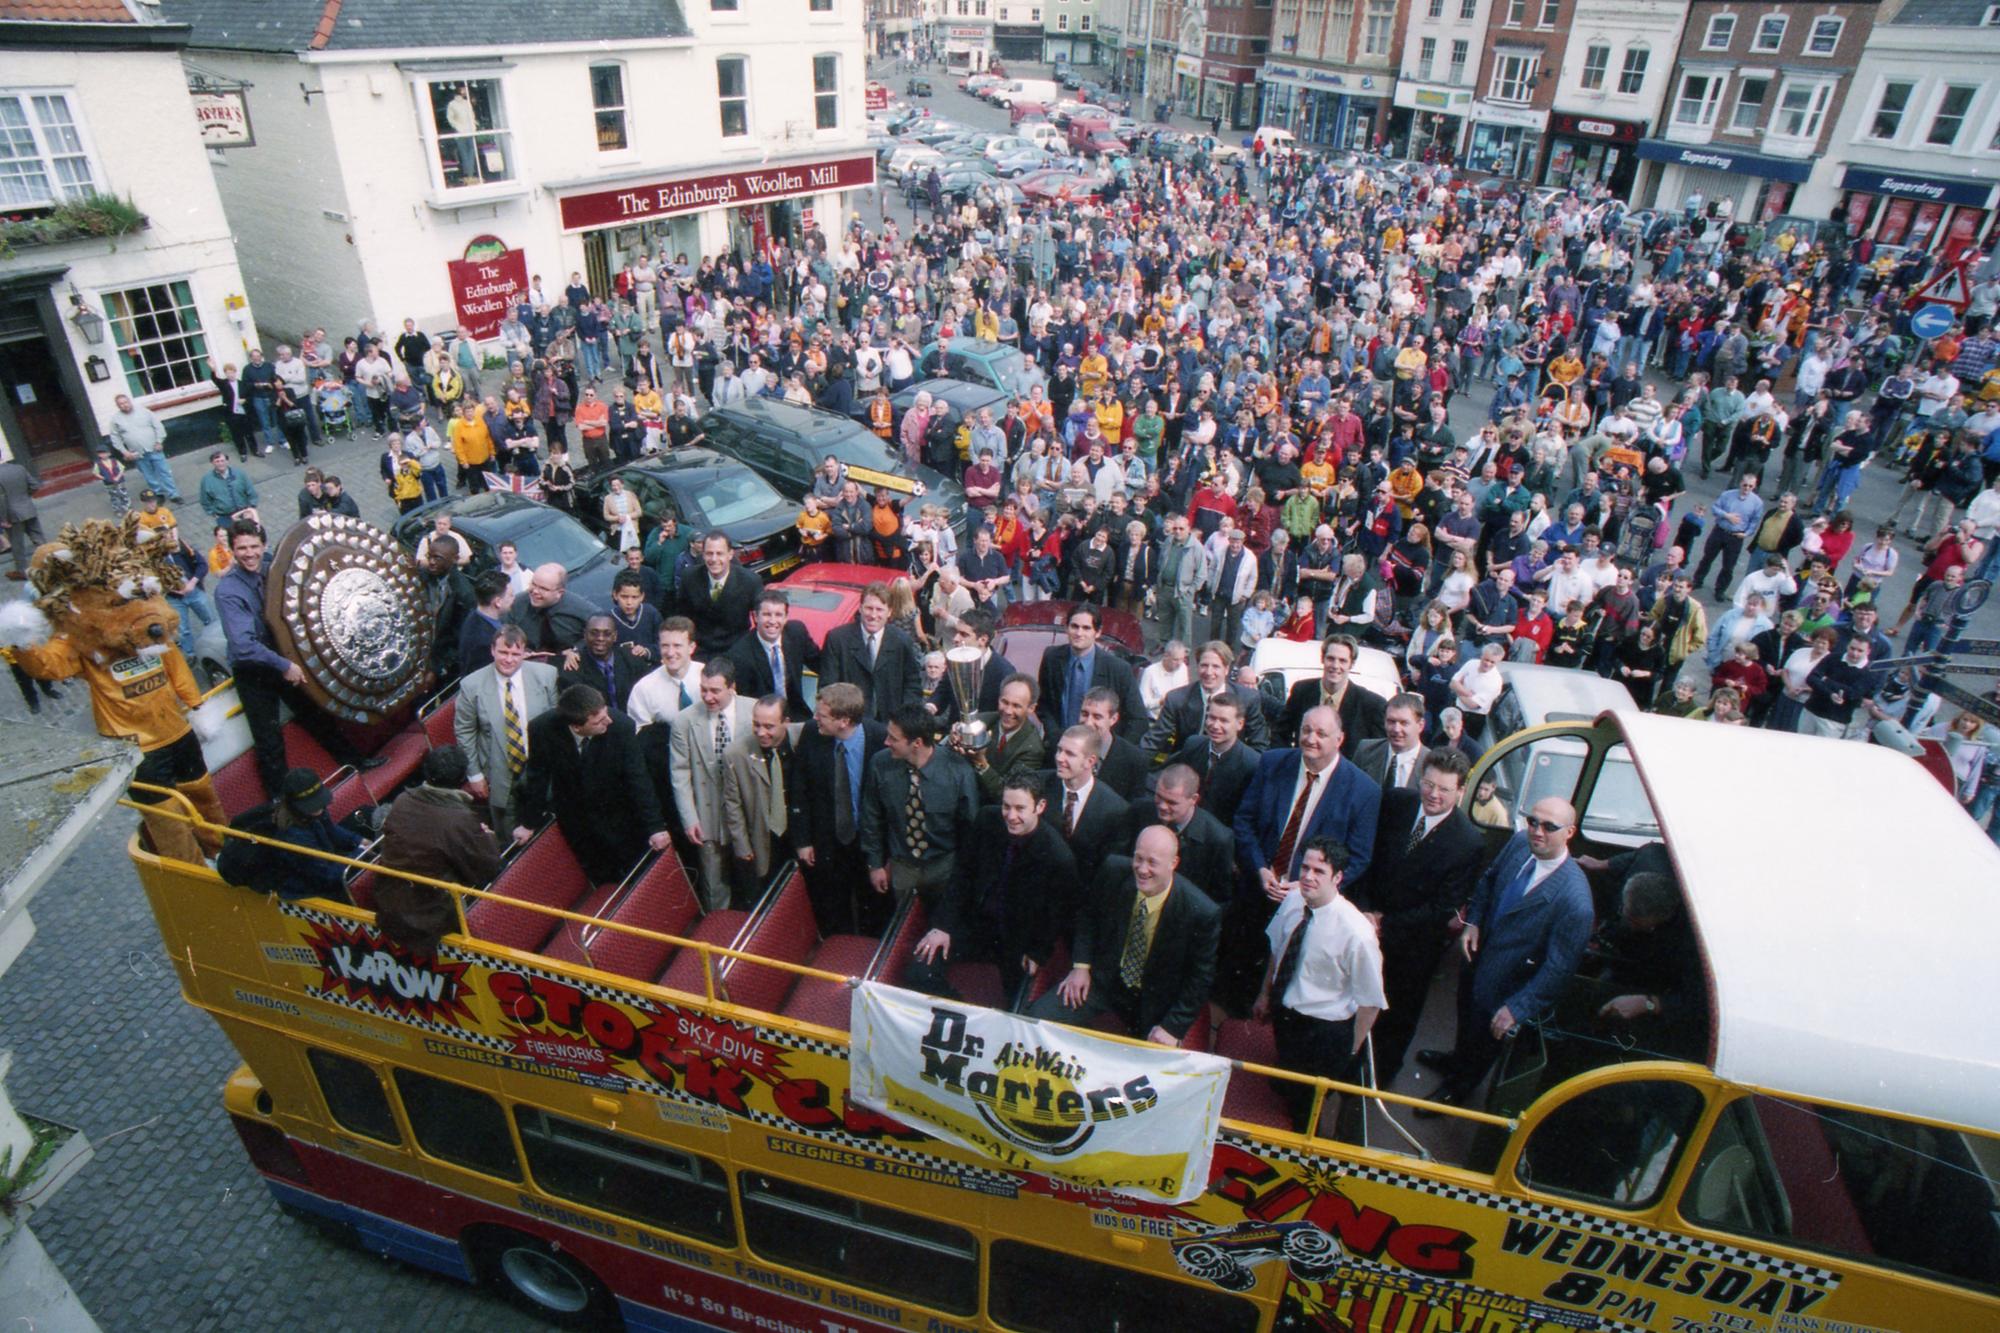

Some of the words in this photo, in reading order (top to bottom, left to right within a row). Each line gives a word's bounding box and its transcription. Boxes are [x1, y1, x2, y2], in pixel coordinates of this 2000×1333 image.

[1680, 150, 1732, 170] Superdrug
[618, 194, 650, 215] The
[657, 180, 738, 210] Edinburgh
[745, 173, 803, 196] Woollen
[810, 166, 839, 186] Mill
[1880, 178, 1946, 198] Superdrug
[465, 278, 518, 299] Edinburgh
[479, 266, 500, 280] The
[462, 299, 503, 316] Woollen
[505, 294, 521, 309] Mi
[332, 945, 445, 1002] KAPOW
[235, 990, 301, 1016] SUNDAYS
[488, 971, 753, 1121] STOCK
[525, 1039, 605, 1063] FIREWORKS
[678, 1016, 716, 1044] SKY
[721, 1035, 765, 1067] DIVE
[920, 1006, 985, 1058] Dr.
[428, 1040, 505, 1066] SKEGNESS
[511, 1057, 580, 1083] STADIUM
[993, 1041, 1088, 1081] AirWair
[920, 1047, 1159, 1123] Martens
[770, 1139, 866, 1168] SKEGNESS
[873, 1161, 961, 1187] STADIUM
[1049, 1177, 1107, 1196] STUNT
[1094, 1213, 1118, 1227] KIDS
[1141, 1218, 1174, 1237] FREE
[519, 1195, 617, 1237] Skegness
[638, 1230, 712, 1266] Butlins
[735, 1260, 822, 1300] Fantasy
[831, 1288, 901, 1323] Island
[1501, 1217, 1827, 1316] WEDNESDAY
[663, 1284, 695, 1306] It's
[700, 1296, 725, 1315] So
[1337, 1266, 1411, 1290] GNESS
[1421, 1282, 1528, 1315] STADIUM
[1780, 1313, 1819, 1330] BANK
